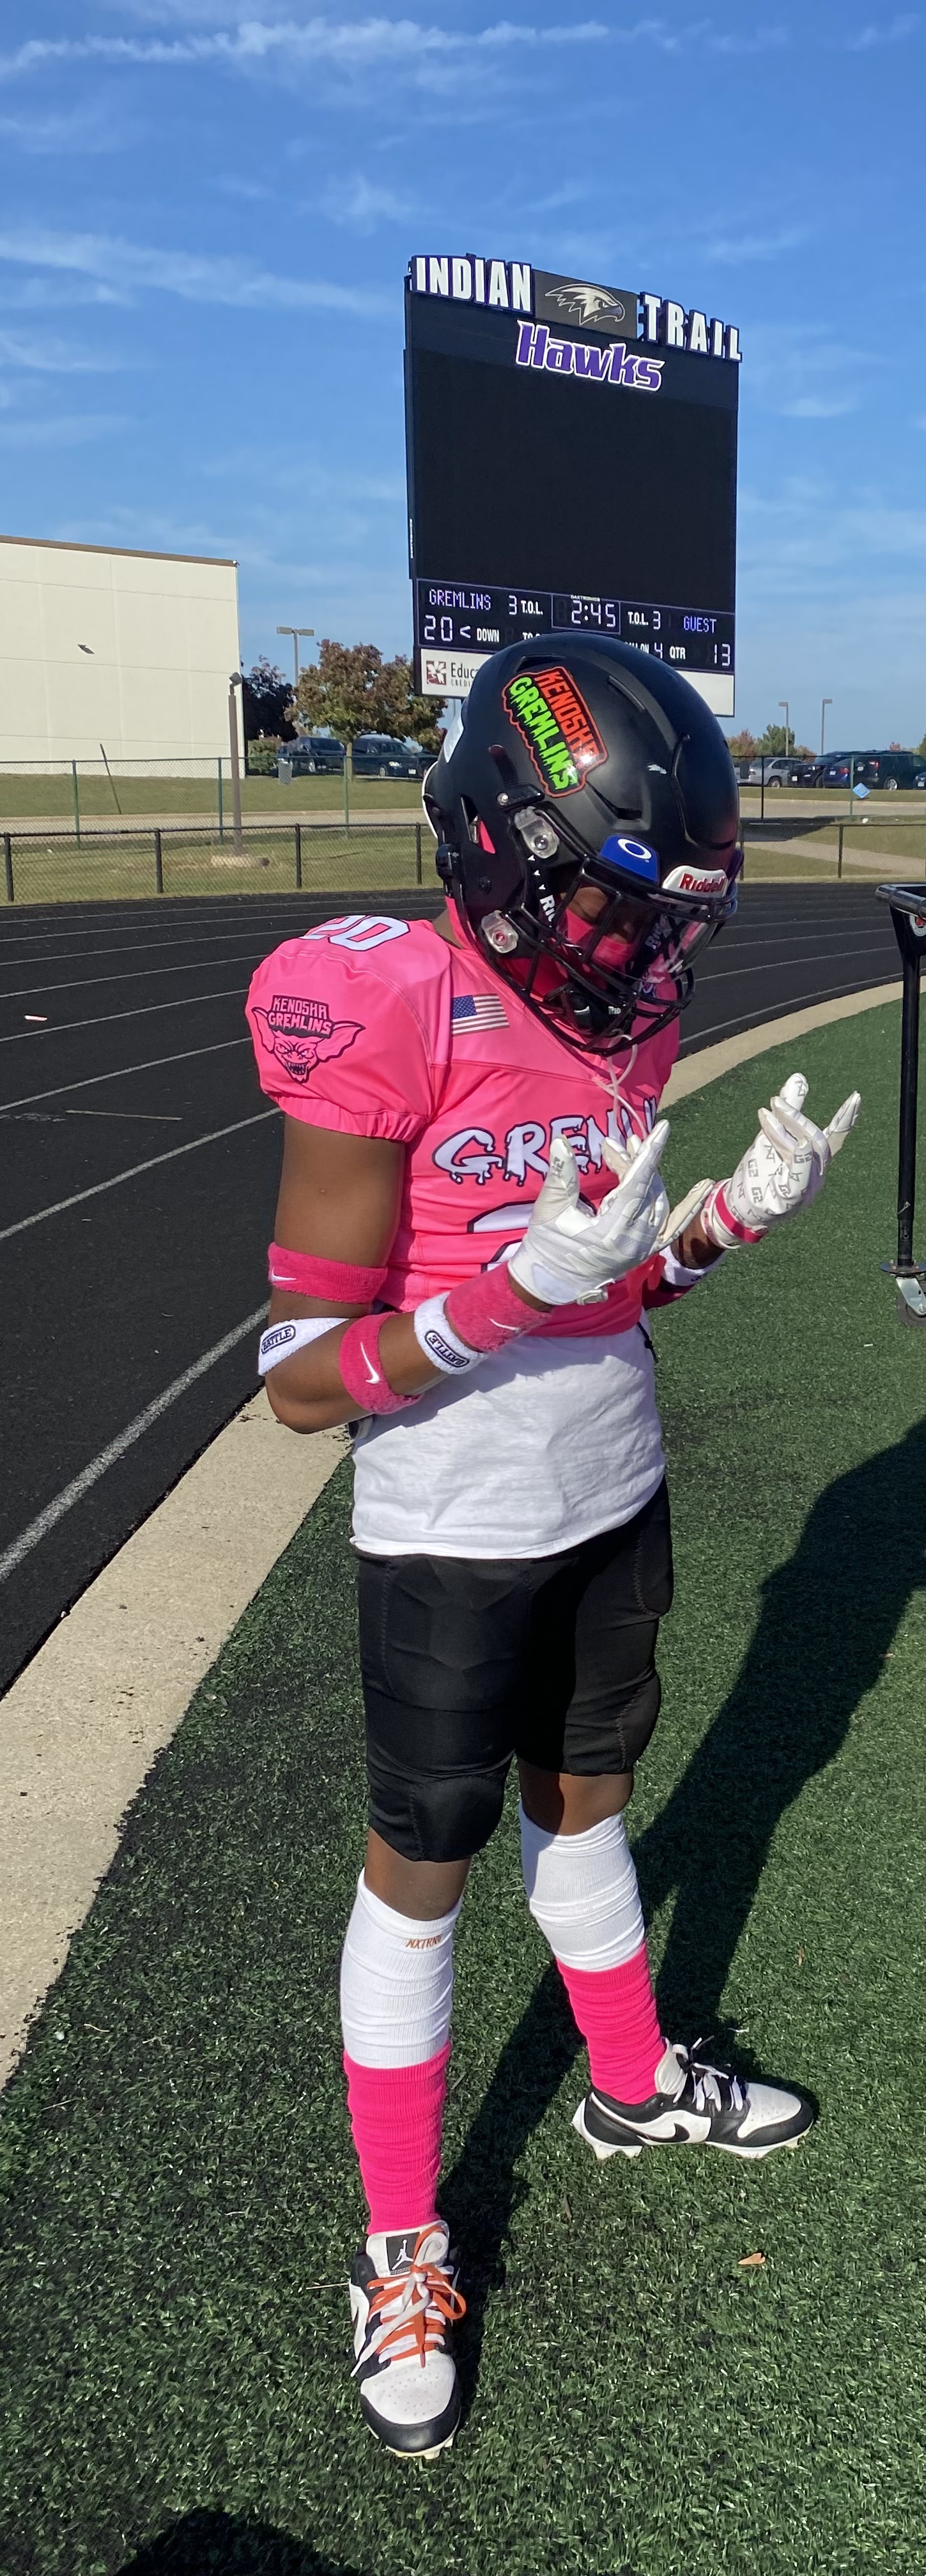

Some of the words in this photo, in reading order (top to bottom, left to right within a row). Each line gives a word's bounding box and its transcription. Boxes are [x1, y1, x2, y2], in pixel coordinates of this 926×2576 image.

[415, 257, 532, 313] INDIAN
[643, 295, 742, 361] TRAIL
[516, 319, 665, 392] Hawks
[429, 588, 491, 611] GREMLINS
[509, 595, 518, 615] 3
[520, 600, 543, 615] T.O.L.
[571, 600, 615, 627] 2:45
[628, 611, 649, 625] T.O.L.
[653, 611, 661, 630] 3
[424, 615, 453, 642] 20
[683, 615, 716, 634] GUEST
[477, 628, 500, 643] DOWN
[654, 642, 663, 659] 4
[670, 647, 686, 660] QTR
[714, 643, 731, 666] 13
[451, 662, 479, 679] Educ
[451, 679, 472, 687] CREDI
[510, 677, 578, 790] GREMLINS
[298, 914, 410, 952] 20
[273, 997, 328, 1020] KENOSHA
[268, 1013, 334, 1036] GREMLINS
